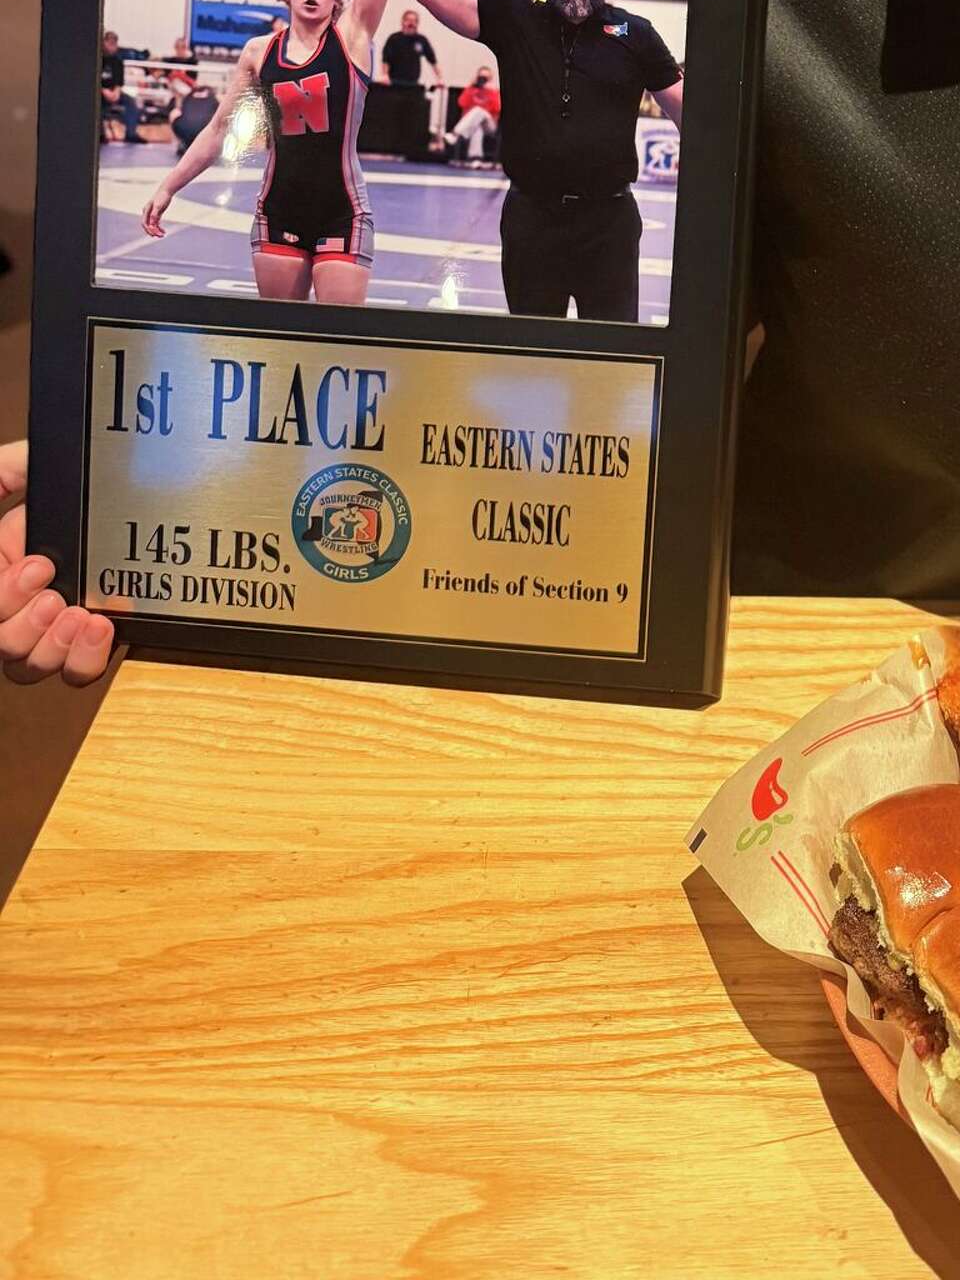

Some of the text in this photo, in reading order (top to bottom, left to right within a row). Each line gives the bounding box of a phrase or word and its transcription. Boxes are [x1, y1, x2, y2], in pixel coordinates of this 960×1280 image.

[273, 72, 330, 136] N
[106, 349, 388, 452] 1st PLACE
[420, 423, 630, 478] EASTERN STATES
[296, 467, 408, 525] EASTERN STATES CLASSIC
[124, 521, 291, 574] 145 LBS.
[320, 537, 379, 554] WRESTLING
[472, 498, 571, 547] CLASSIC
[99, 568, 298, 612] GIRLS DIVISION
[323, 562, 369, 580] GIRLS
[422, 568, 629, 603] Friends of Section 9
